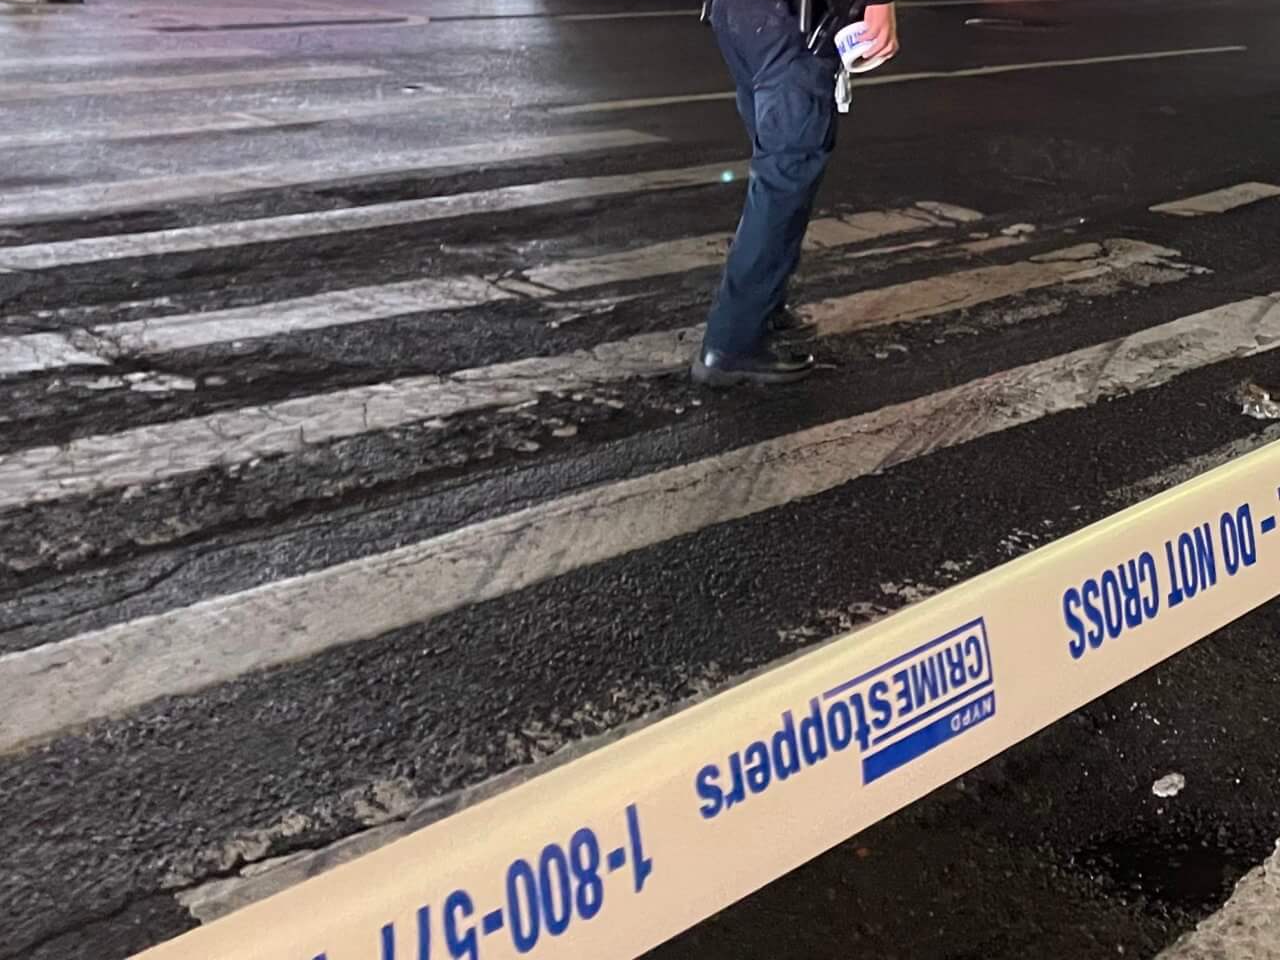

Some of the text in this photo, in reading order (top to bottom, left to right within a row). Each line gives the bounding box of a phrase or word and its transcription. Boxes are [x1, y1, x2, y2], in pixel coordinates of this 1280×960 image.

[1165, 522, 1218, 608] NOT
[1219, 503, 1257, 576] DO
[1063, 551, 1160, 659] CROSS
[950, 696, 993, 732] NYPD
